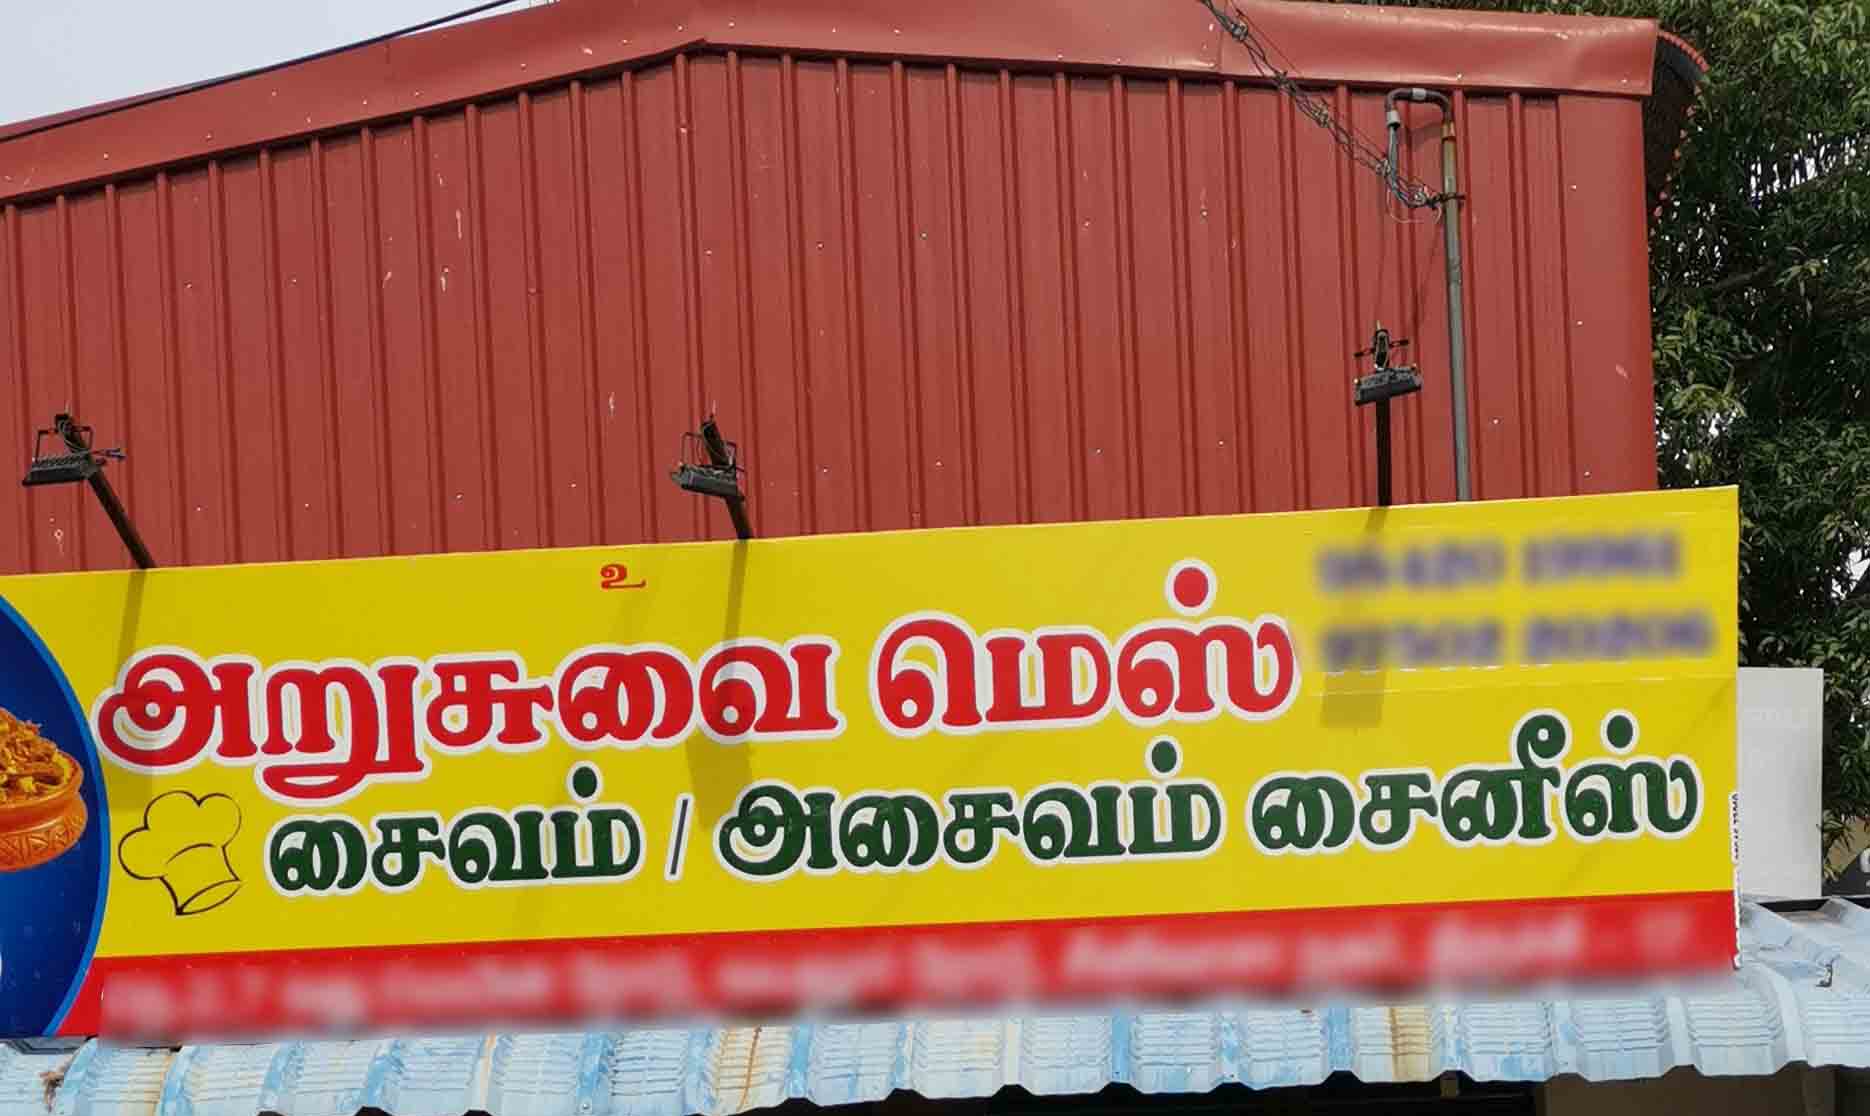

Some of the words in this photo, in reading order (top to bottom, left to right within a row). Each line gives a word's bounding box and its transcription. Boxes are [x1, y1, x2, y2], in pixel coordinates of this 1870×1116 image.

[600, 564, 647, 590] உ
[97, 642, 841, 801] அறுசுவை
[875, 567, 1295, 731] மெஸ்
[268, 765, 643, 892] சைவம்
[717, 741, 1223, 877] அசைவம்
[1250, 714, 1699, 850] சைனீஸ்
